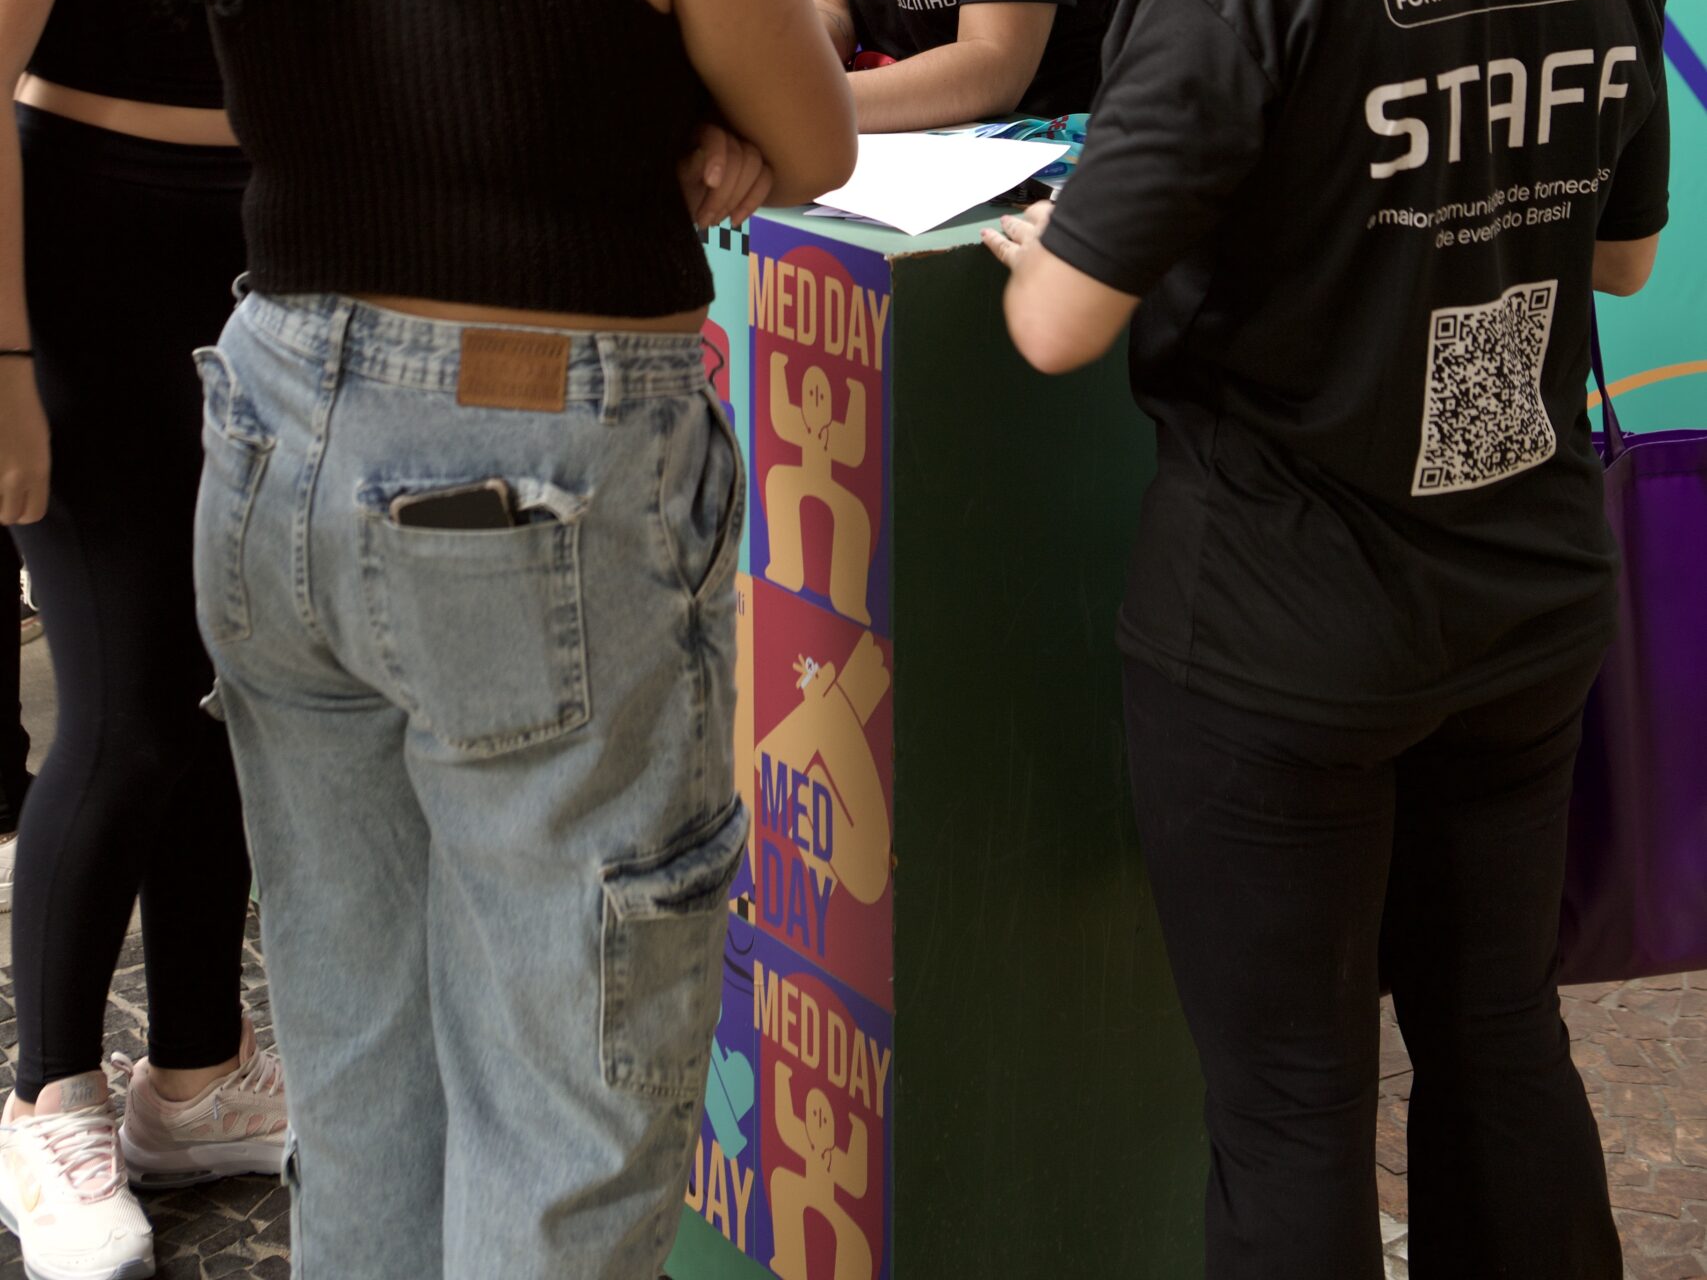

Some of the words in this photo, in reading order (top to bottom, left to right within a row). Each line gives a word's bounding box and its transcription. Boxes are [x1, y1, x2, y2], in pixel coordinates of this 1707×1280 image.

[1365, 46, 1637, 179] STAFF
[1378, 207, 1434, 228] maior
[1507, 184, 1530, 202] de
[1435, 228, 1455, 249] de
[1502, 211, 1522, 230] do
[1526, 201, 1572, 225] Brasil
[749, 251, 817, 347] MED
[824, 275, 890, 372] DAY
[761, 751, 833, 863] MED
[762, 837, 833, 959] DAY
[753, 959, 820, 1070] MED
[827, 1008, 891, 1119] DAY
